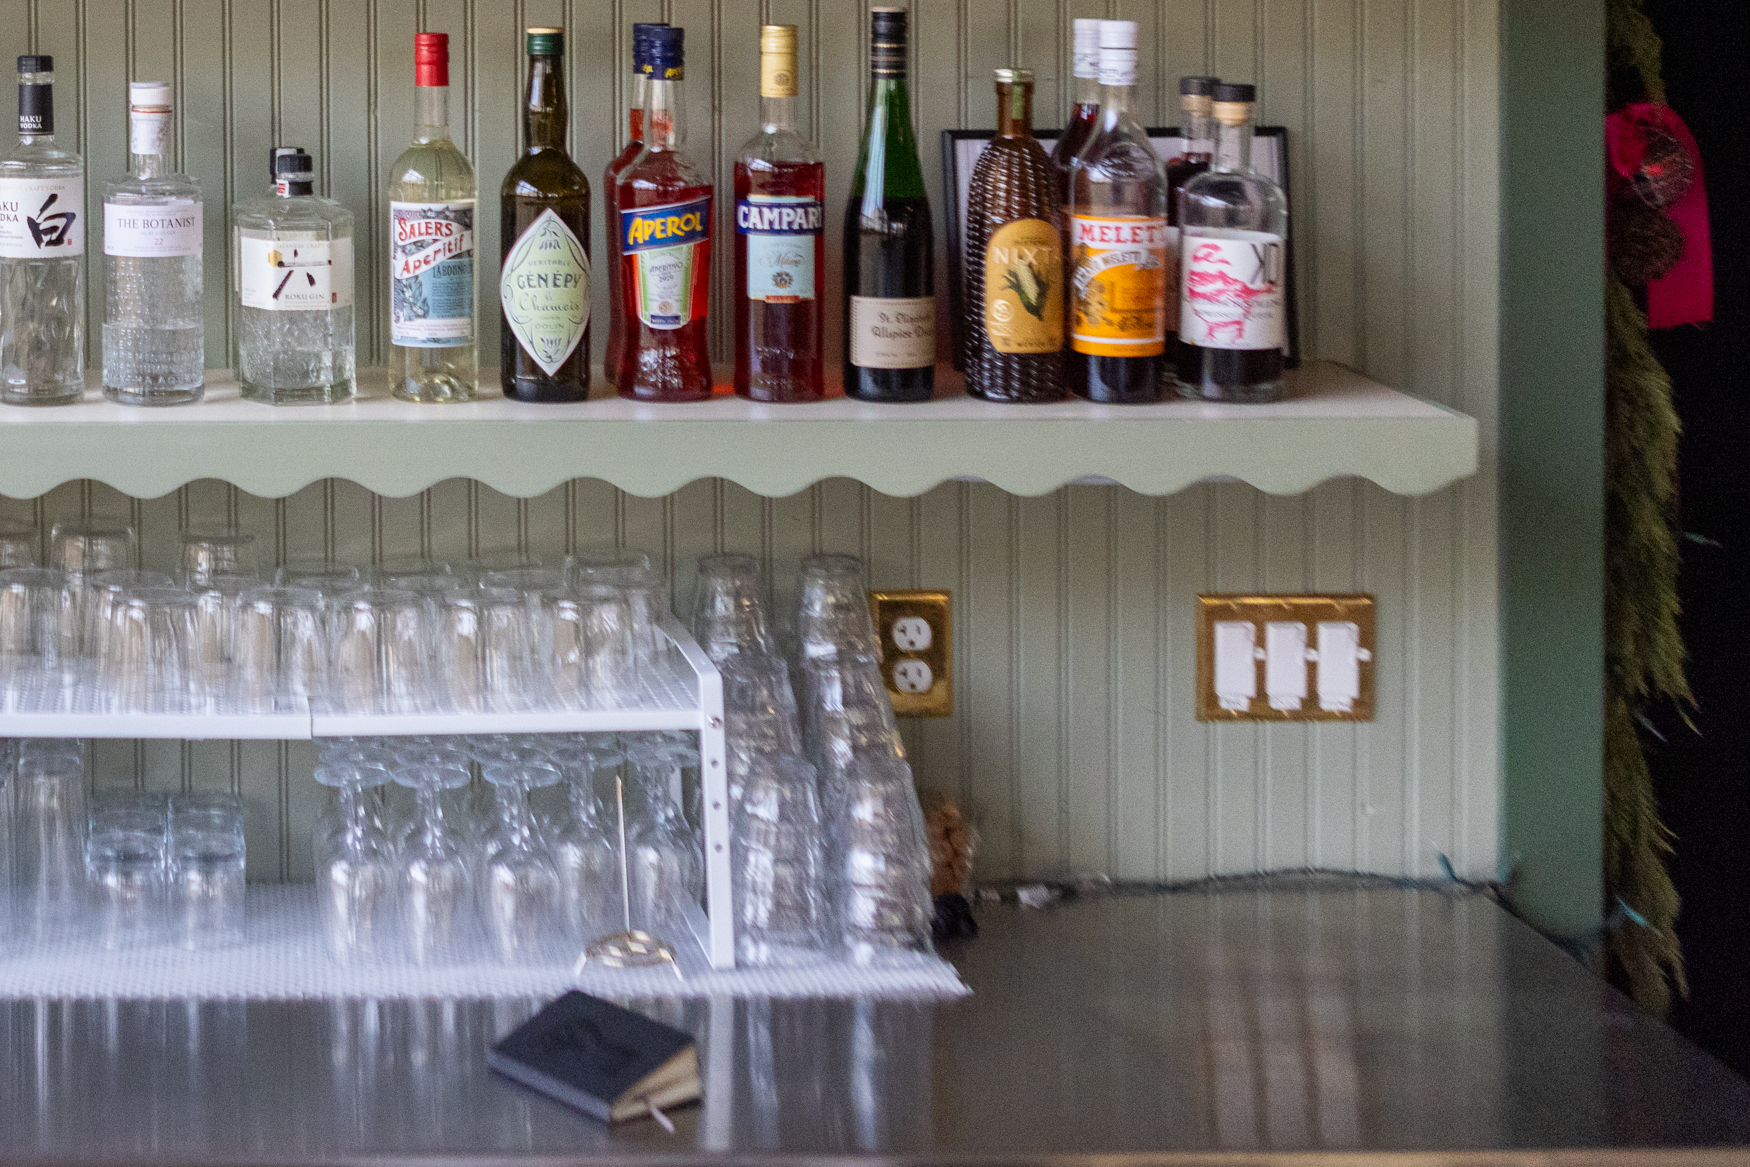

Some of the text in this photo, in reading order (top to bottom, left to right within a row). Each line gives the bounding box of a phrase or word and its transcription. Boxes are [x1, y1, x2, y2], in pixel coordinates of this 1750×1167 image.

[19, 115, 42, 123] HAKU
[27, 193, 77, 249] 白
[118, 217, 196, 229] THE BOTANIST
[398, 217, 453, 242] SALERS
[627, 212, 704, 245] APEROL
[154, 238, 164, 246] 22
[400, 233, 465, 277] Aperitif
[649, 262, 683, 273] APERITIVO
[517, 270, 582, 290] GÉNÉPY
[520, 293, 580, 311] Chamois
